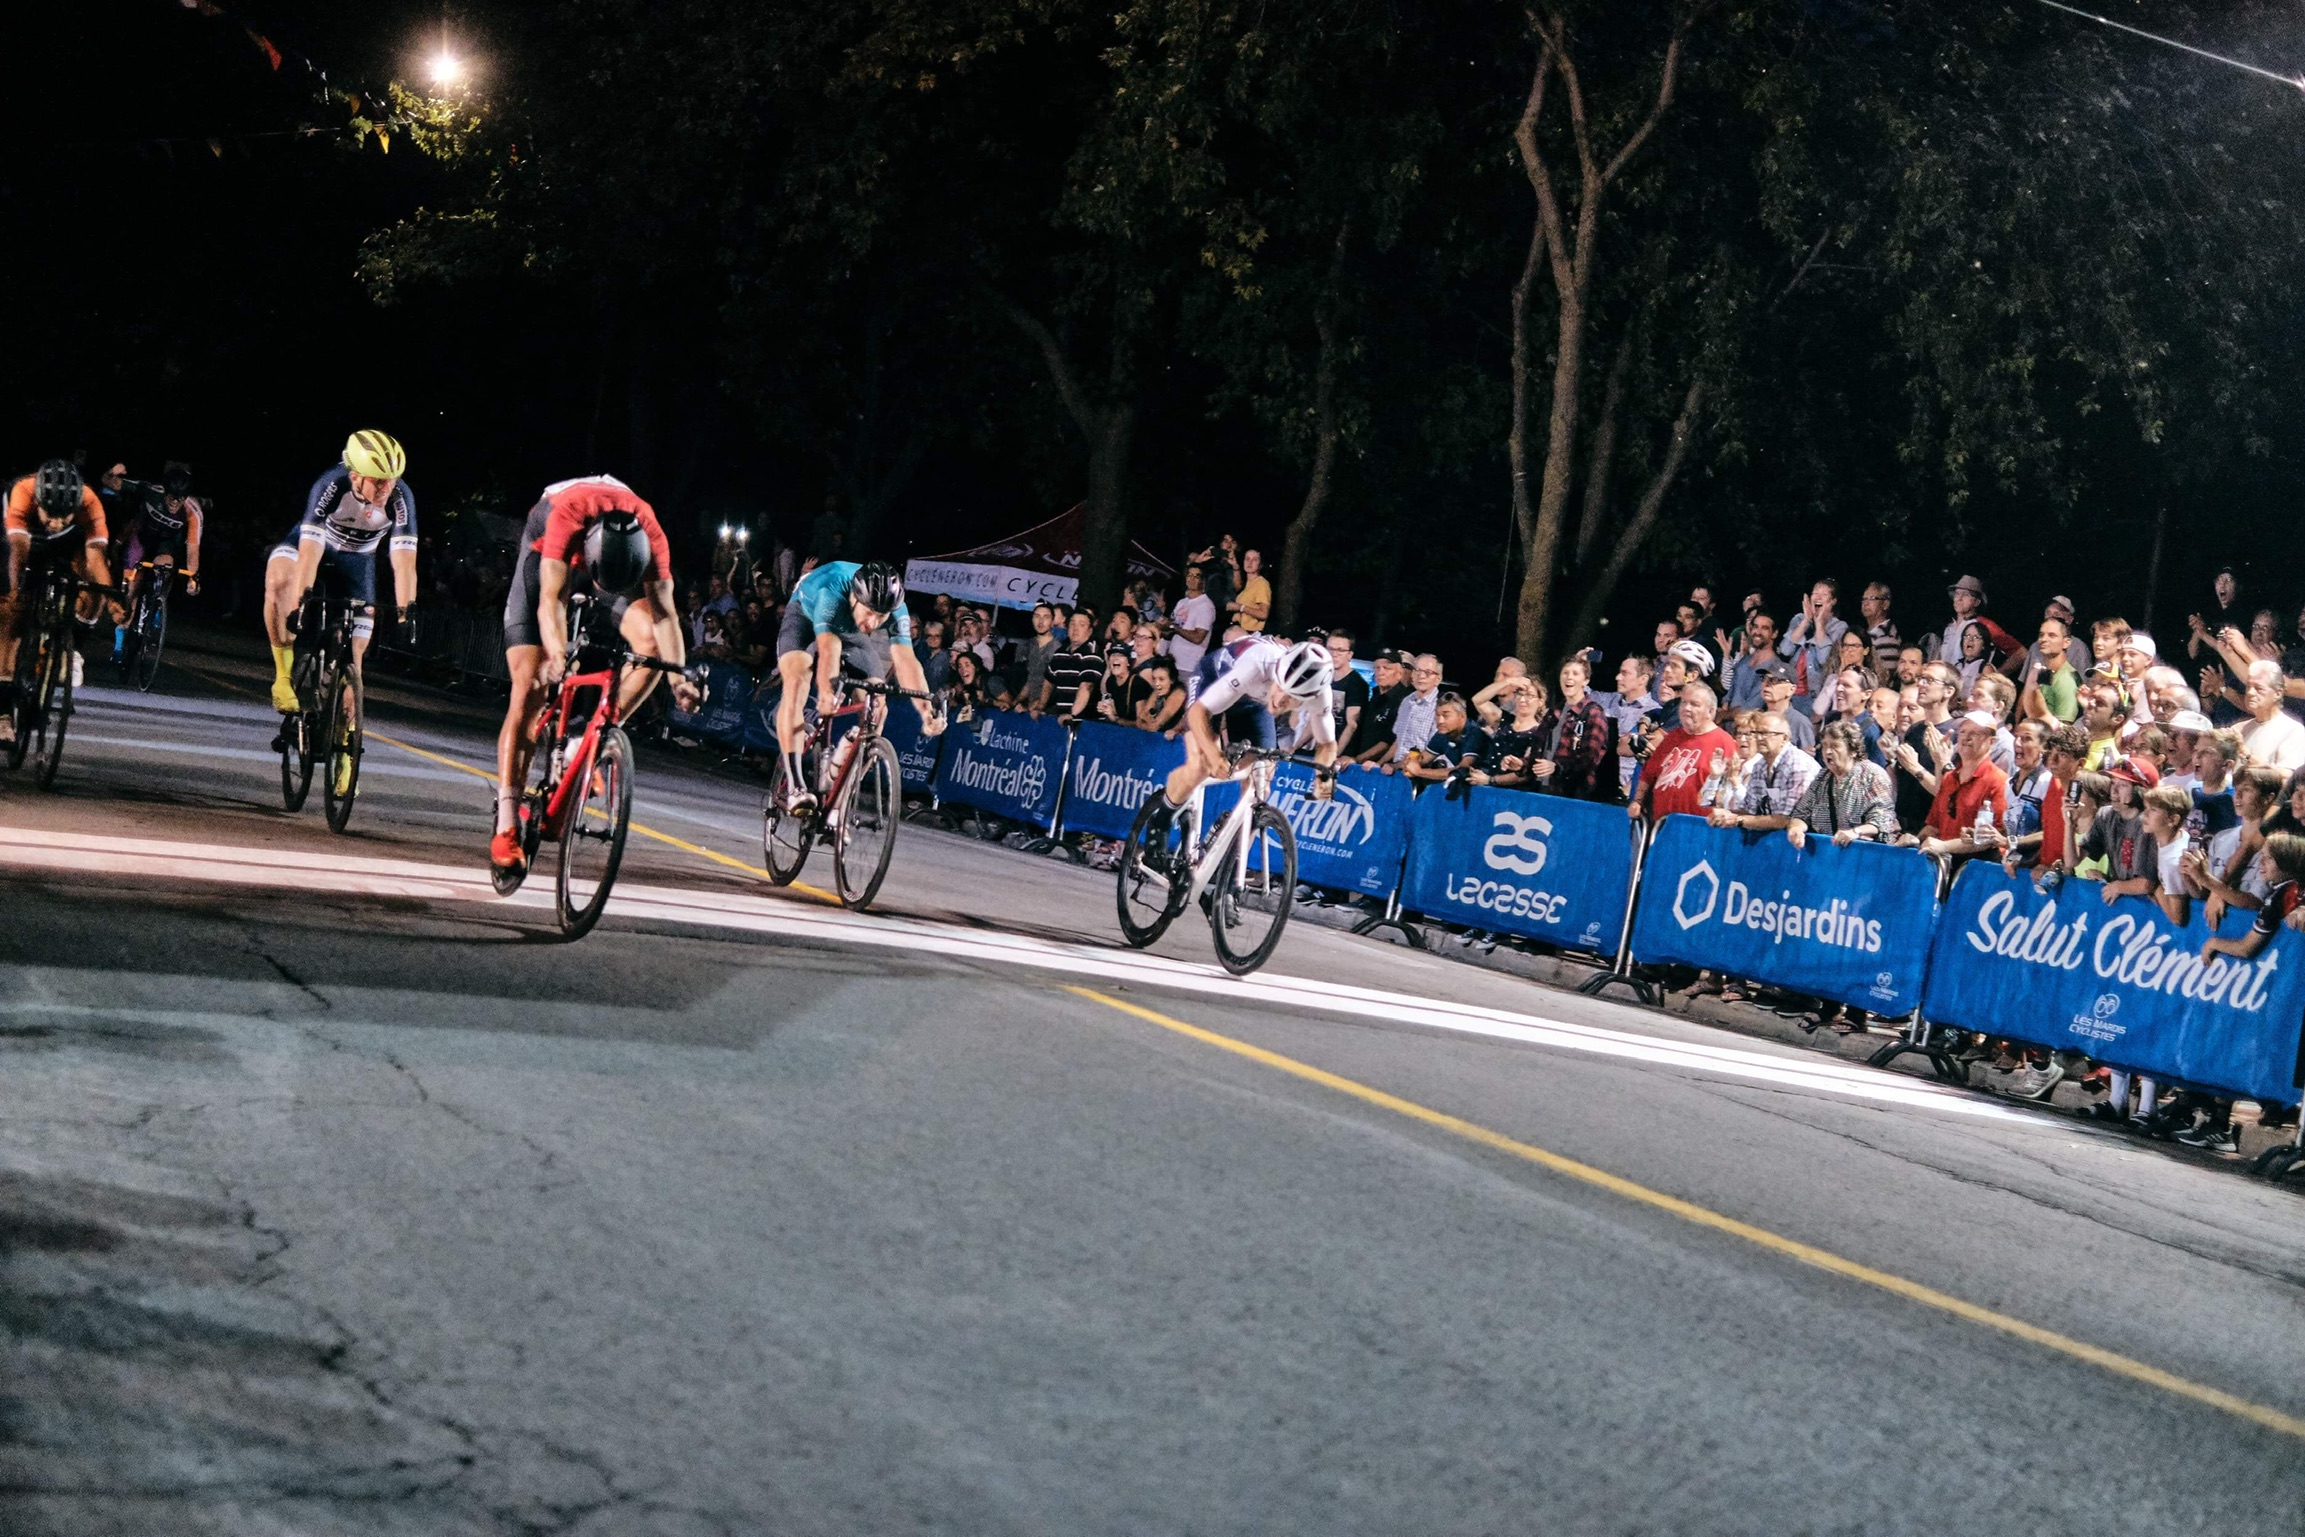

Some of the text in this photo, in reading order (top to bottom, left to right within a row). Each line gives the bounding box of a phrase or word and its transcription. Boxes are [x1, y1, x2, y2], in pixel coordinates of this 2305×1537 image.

[990, 728, 1029, 754] Lachine
[950, 748, 1026, 798] Montréal
[1074, 754, 1165, 810] Montré
[1276, 776, 1316, 793] CYCLE
[1266, 790, 1364, 844] NERON
[1723, 881, 1882, 953] Desjardins
[1966, 890, 2279, 1011] Salut Clément
[2073, 1014, 2093, 1027] LES
